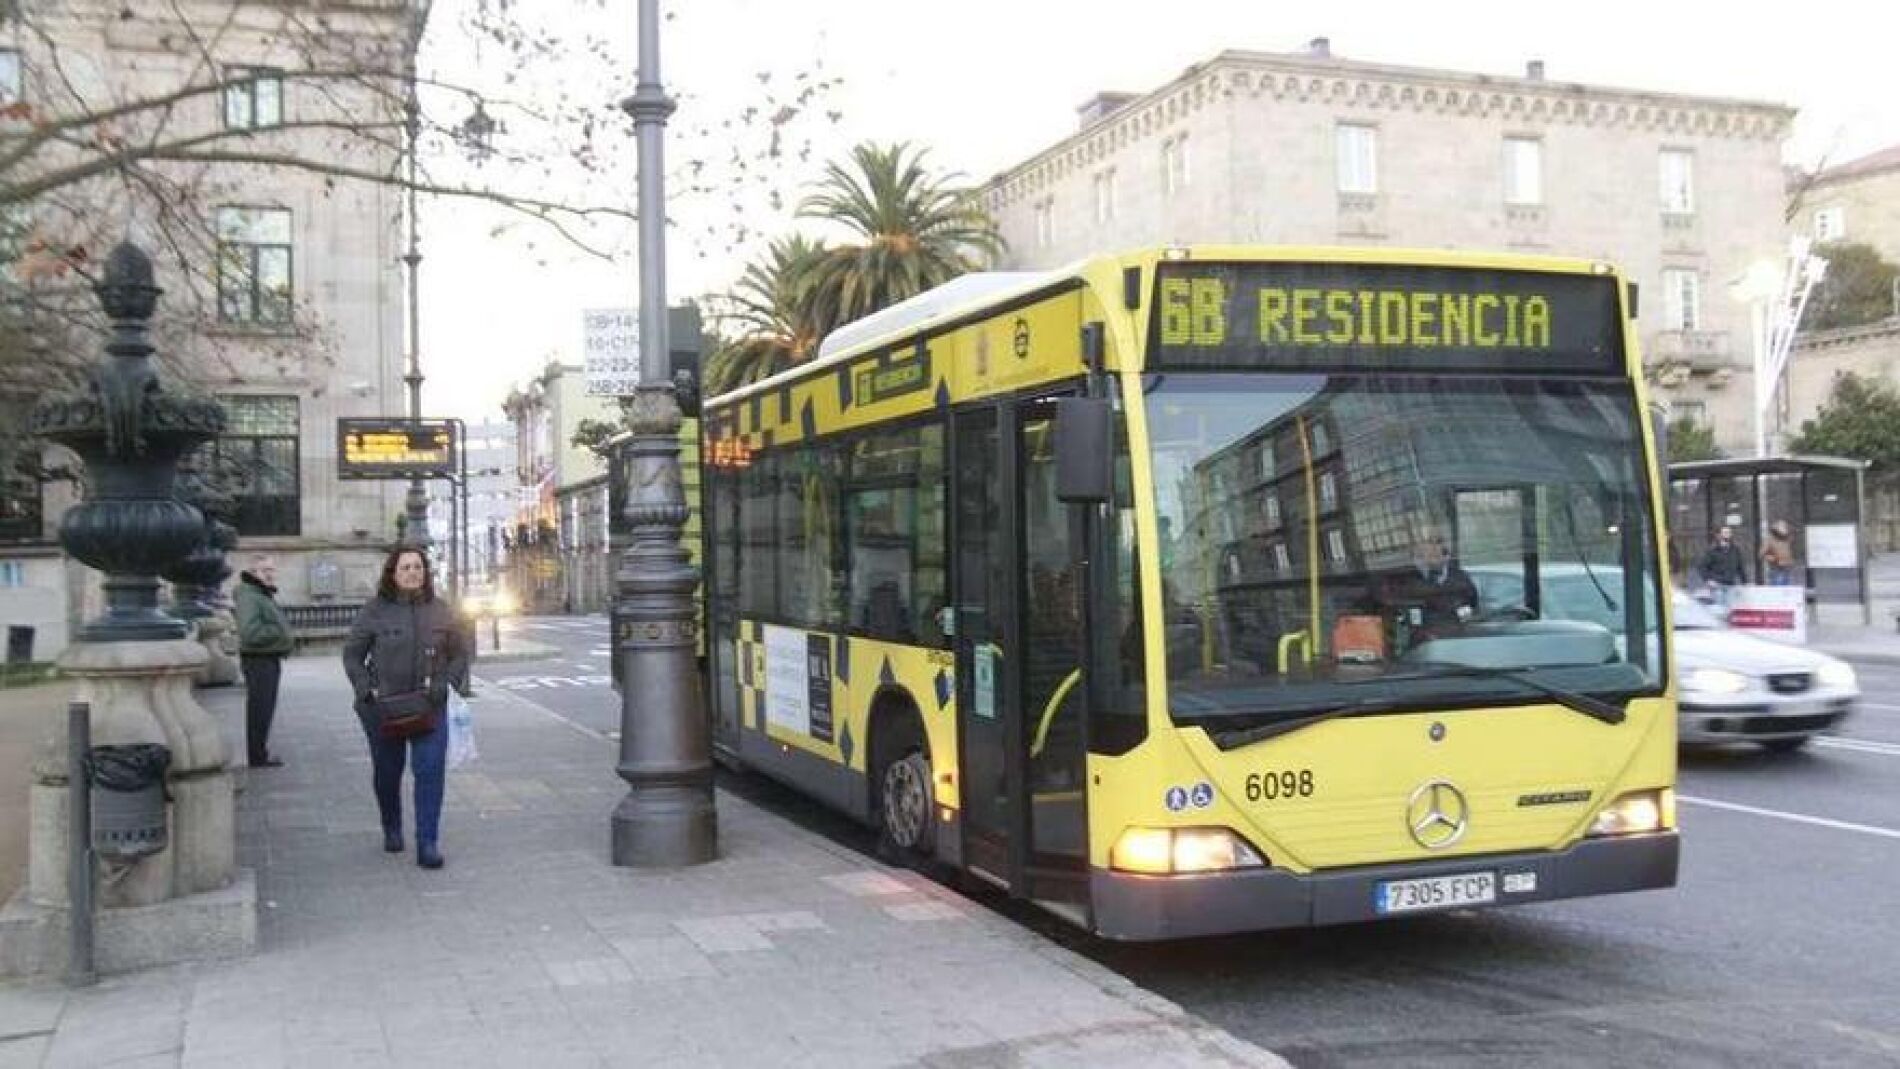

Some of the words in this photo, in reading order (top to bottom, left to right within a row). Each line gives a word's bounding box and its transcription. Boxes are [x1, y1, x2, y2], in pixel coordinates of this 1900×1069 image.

[1160, 277, 1226, 347] 6B
[1260, 288, 1551, 348] RESIDENCIA
[1245, 768, 1314, 802] 6098
[1390, 880, 1445, 911] 7305
[1451, 876, 1491, 901] FCP
